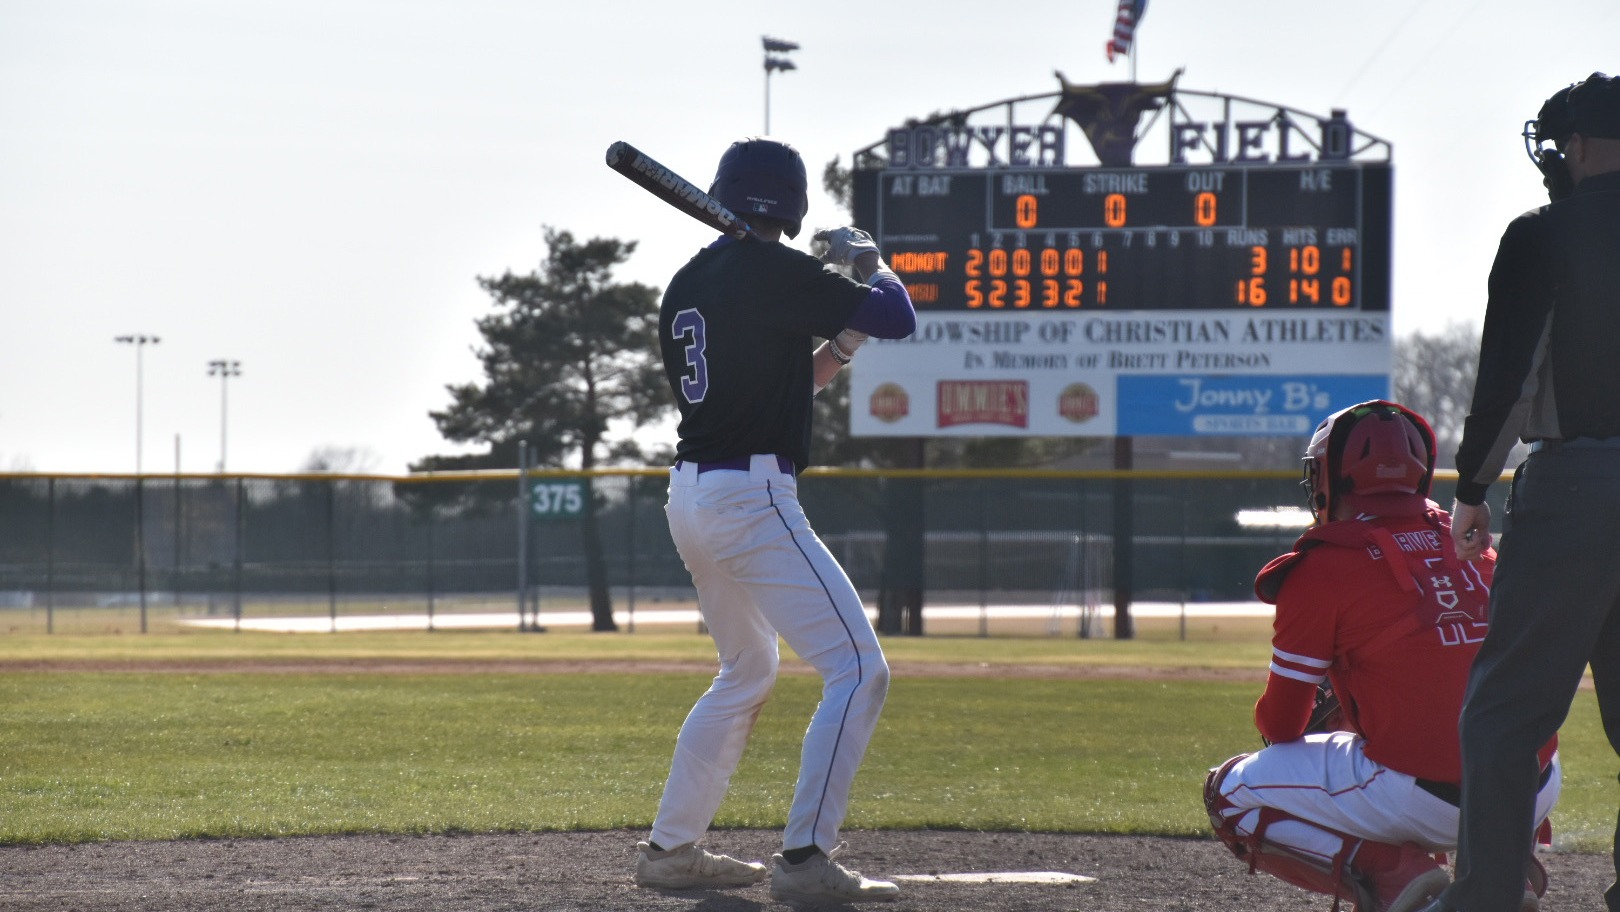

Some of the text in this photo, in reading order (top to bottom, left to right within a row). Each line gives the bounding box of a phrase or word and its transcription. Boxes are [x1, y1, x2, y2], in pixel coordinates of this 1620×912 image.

[890, 120, 1353, 168] BOWYER FIELD
[892, 175, 950, 195] AT BAT
[1003, 174, 1049, 195] BALL
[1084, 174, 1149, 194] STRIKE
[1188, 171, 1225, 192] OUT
[1016, 194, 1037, 228] 0
[1105, 193, 1126, 228] 0
[1195, 192, 1217, 227] 0
[1227, 229, 1268, 246] RUNS
[1283, 229, 1317, 246] HITS
[1326, 228, 1357, 245] ERR
[965, 249, 983, 277] 2
[989, 248, 1007, 277] 0
[1012, 248, 1031, 277] 0
[1041, 248, 1059, 277] 0
[1064, 248, 1083, 277] 0
[1097, 250, 1107, 274] 1
[1252, 246, 1267, 275] 3
[1290, 246, 1320, 275] 10
[1342, 248, 1351, 271] 1
[965, 279, 983, 308] 5
[988, 279, 1007, 308] 2
[1014, 279, 1031, 308] 3
[1043, 279, 1059, 307] 3
[1064, 279, 1083, 307] 2
[1097, 281, 1107, 304] 1
[1237, 277, 1267, 306] 16
[1289, 279, 1320, 304] 14
[1331, 276, 1351, 306] 0
[877, 317, 1383, 345] LOWSHIP OF CHRISTIAN ATHLETES
[671, 307, 709, 404] 3
[1175, 350, 1271, 369] PETERSON
[1174, 378, 1331, 414] Jonny B's
[533, 483, 582, 514] 375
